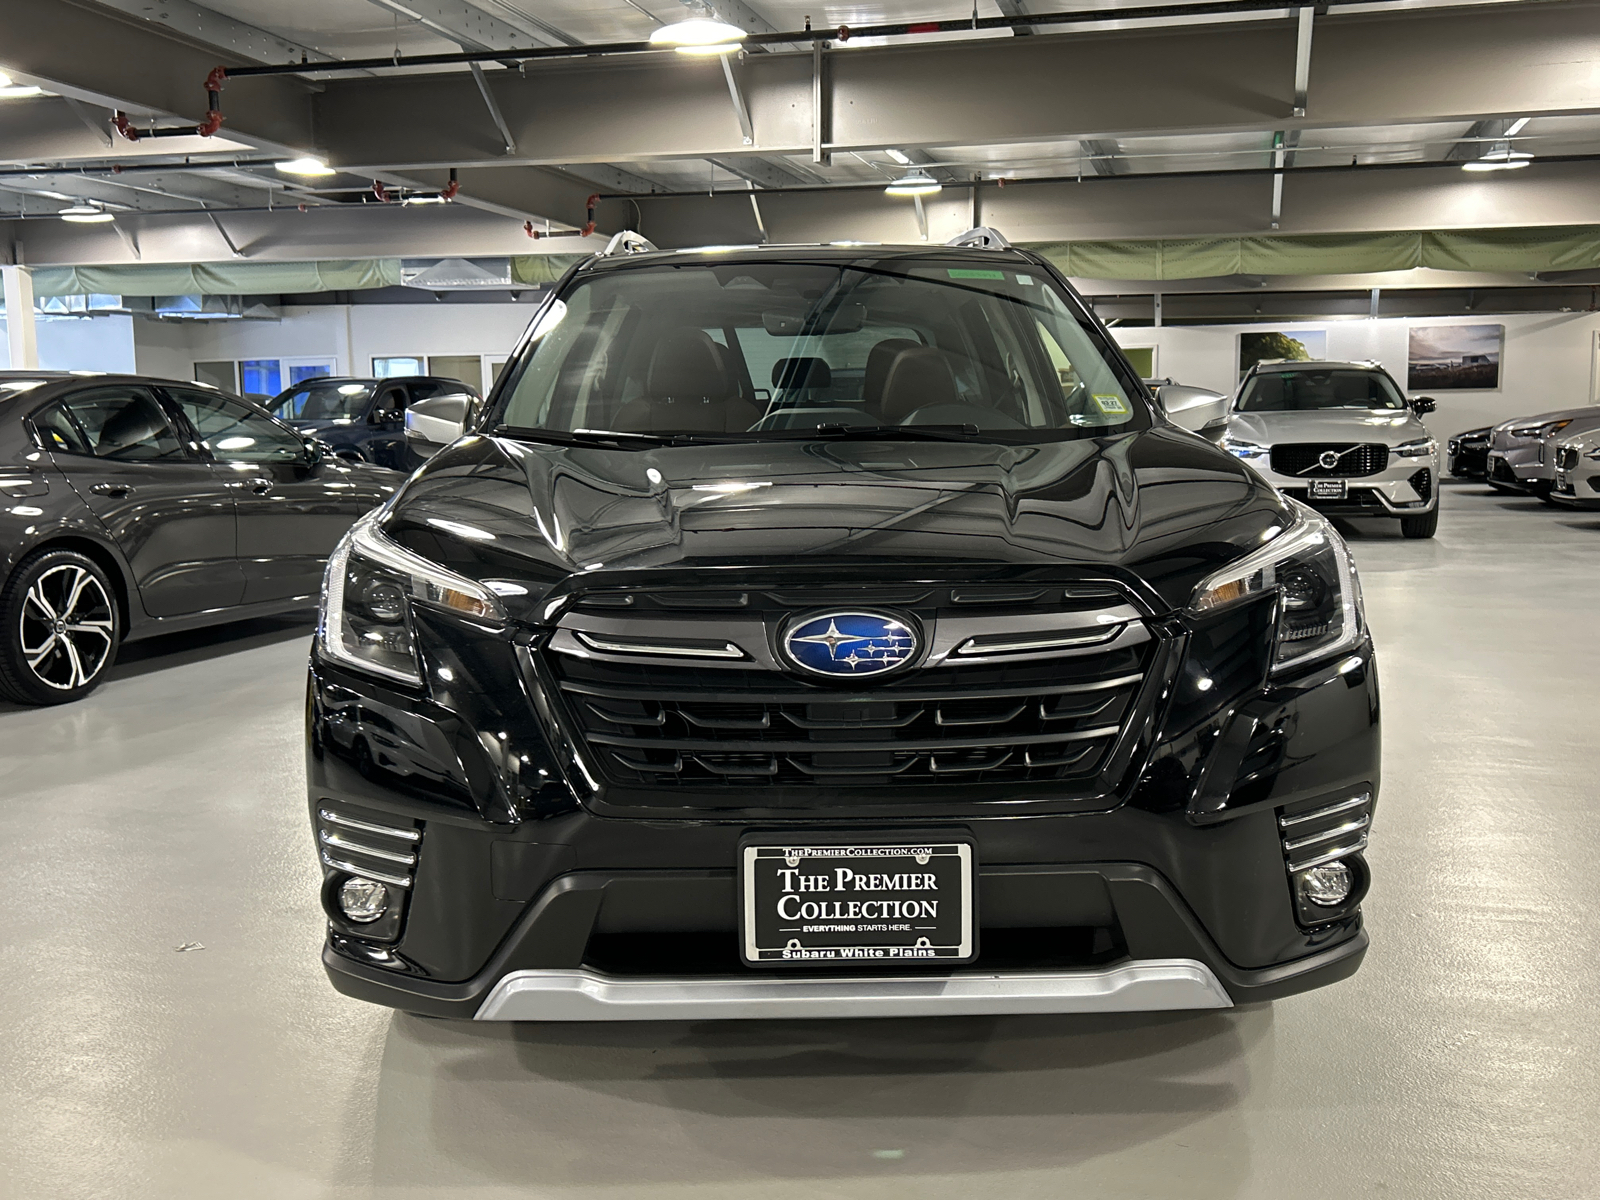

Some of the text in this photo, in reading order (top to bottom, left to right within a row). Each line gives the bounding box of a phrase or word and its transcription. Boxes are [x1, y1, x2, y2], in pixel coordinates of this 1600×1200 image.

[777, 867, 938, 893] THE PREMIER
[777, 895, 938, 920] COLLECTION
[803, 923, 912, 933] EVERYTHING STARTS HERE.
[782, 948, 936, 959] Subaru White Plains
